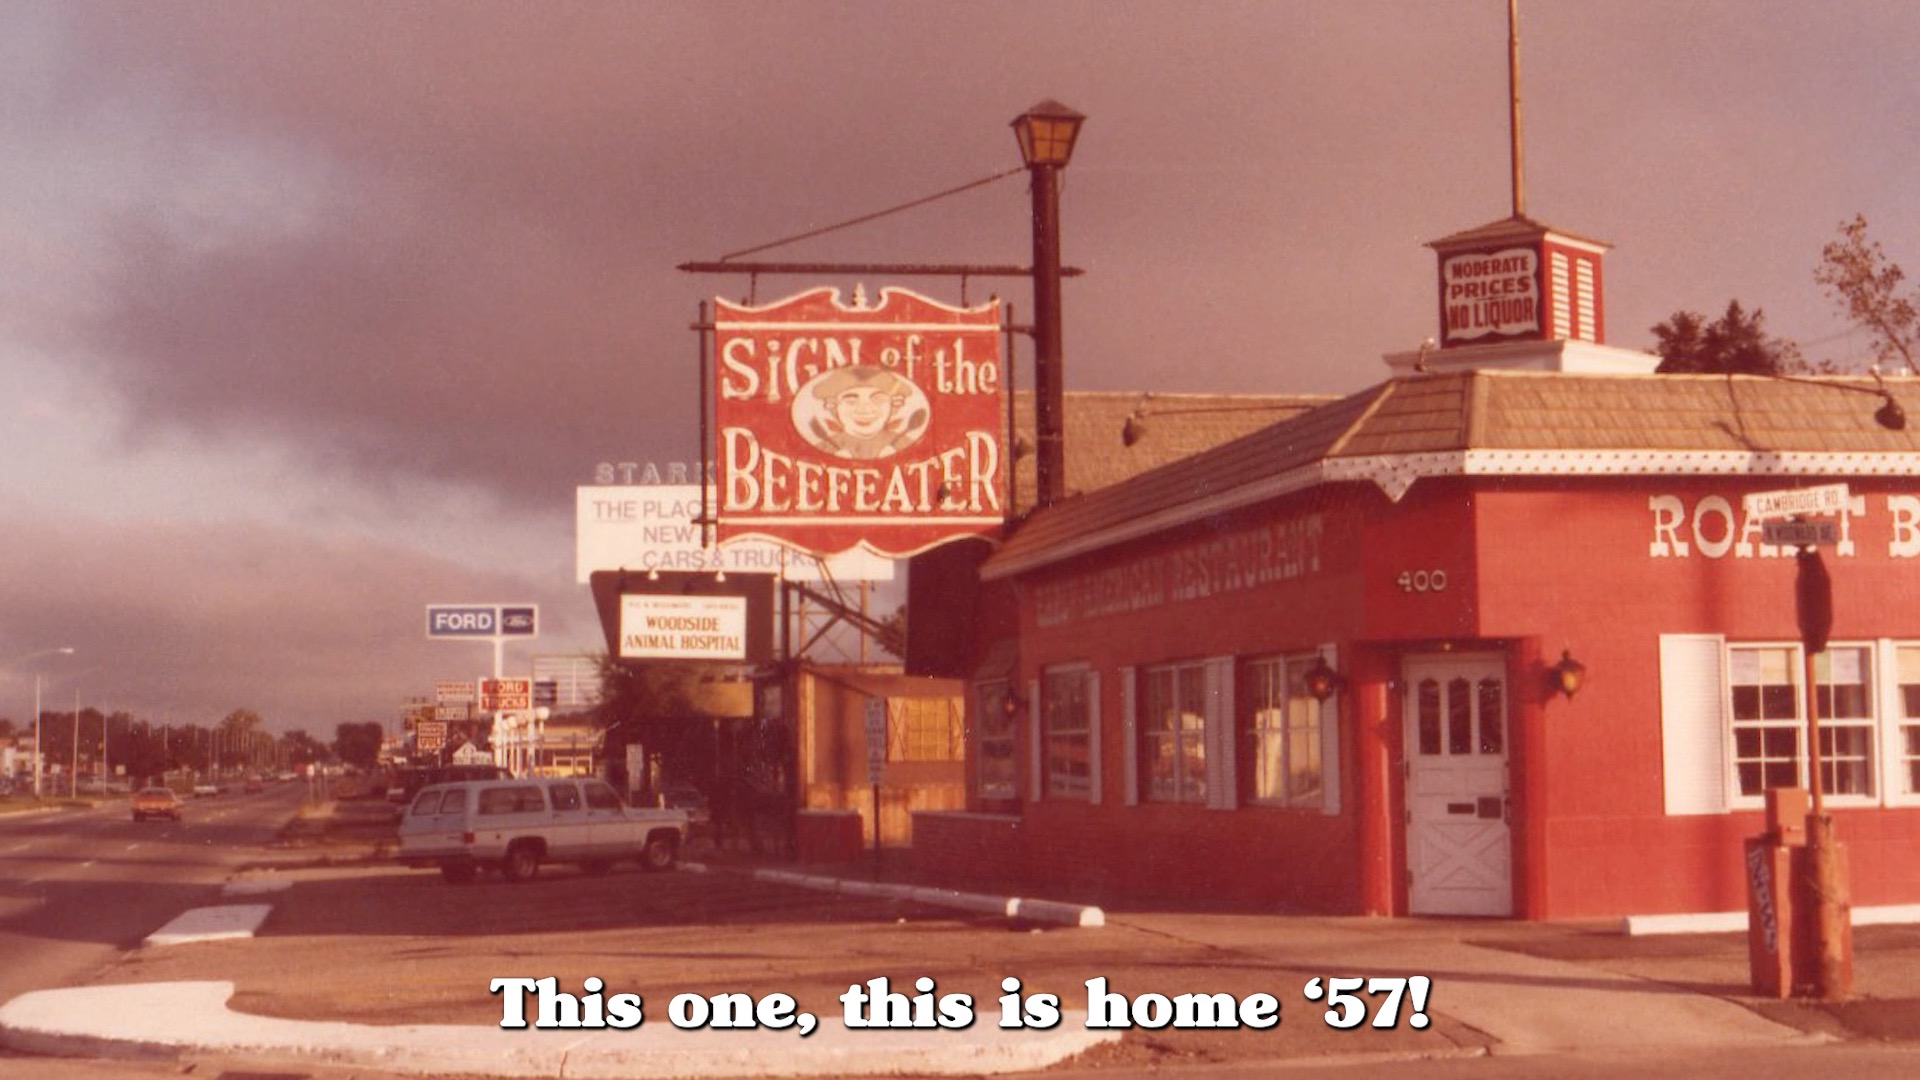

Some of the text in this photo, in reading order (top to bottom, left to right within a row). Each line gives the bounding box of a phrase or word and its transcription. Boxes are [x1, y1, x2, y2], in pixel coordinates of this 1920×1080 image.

[1452, 256, 1529, 279] MODERATE
[1451, 276, 1531, 299] PRICES
[1450, 298, 1533, 330] NO LIQUOR
[881, 334, 922, 381] of
[935, 338, 998, 395] the
[721, 427, 1000, 512] BEEFEATER
[593, 501, 638, 518] THE
[1757, 491, 1820, 513] CAMBRIDGE
[643, 525, 694, 543] NEW
[642, 550, 705, 568] CARS
[711, 549, 725, 567] &
[1397, 570, 1447, 592] 400
[436, 613, 492, 630] FORD
[646, 616, 720, 631] WOODSIDE
[625, 635, 740, 651] ANIMAL HOSPITAL
